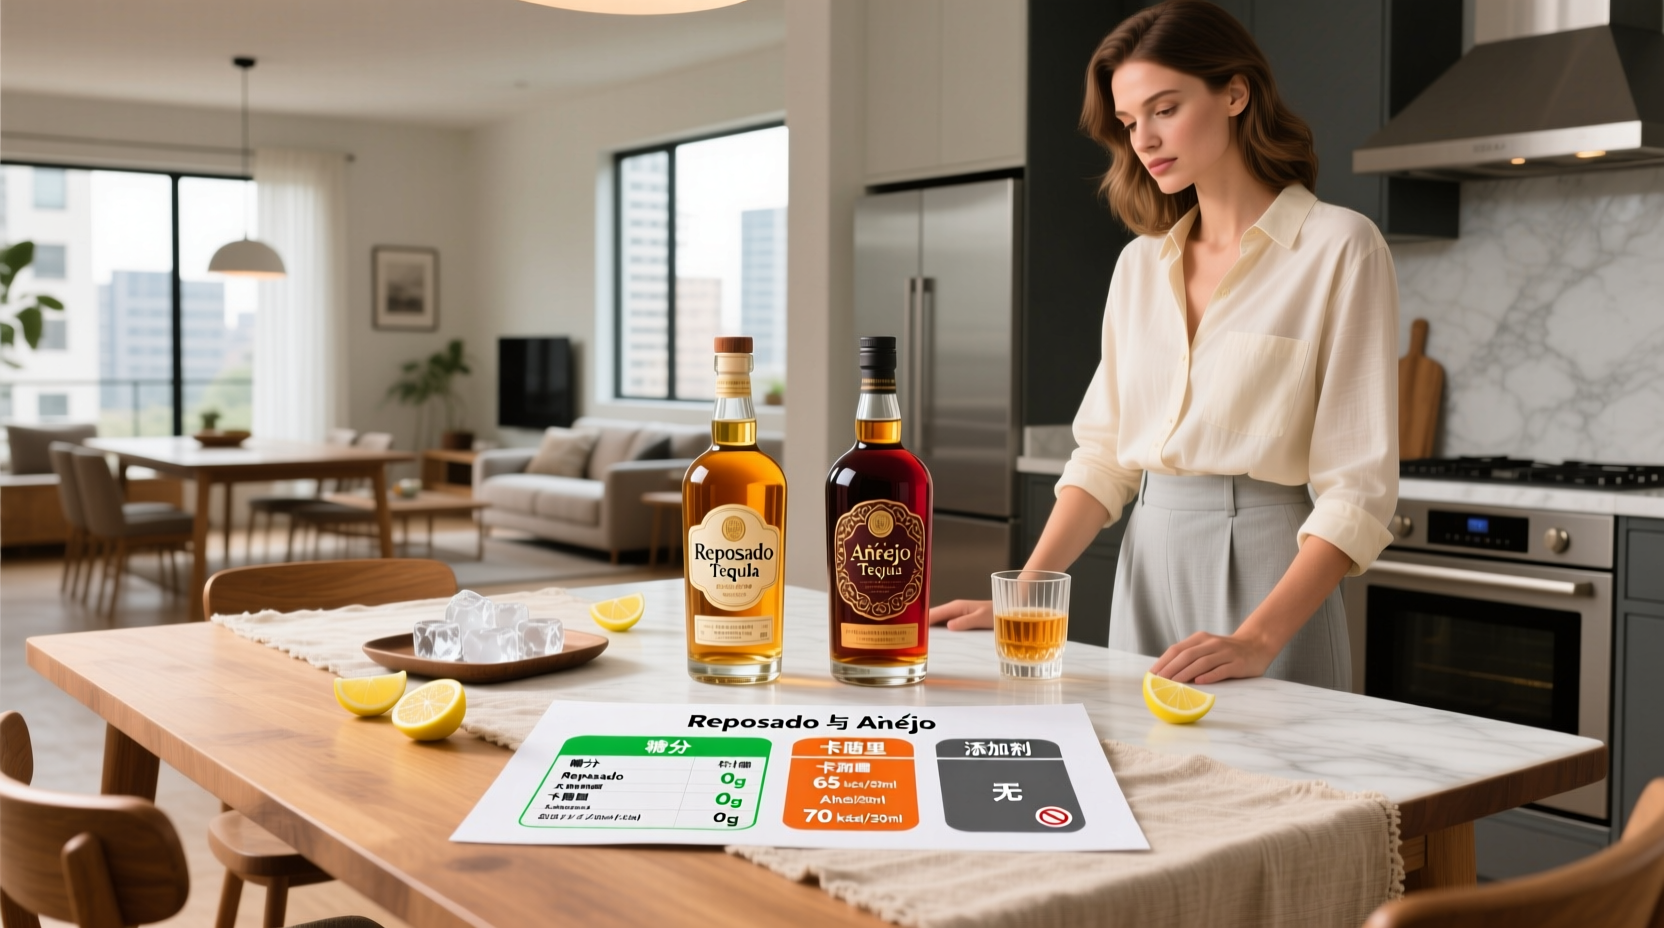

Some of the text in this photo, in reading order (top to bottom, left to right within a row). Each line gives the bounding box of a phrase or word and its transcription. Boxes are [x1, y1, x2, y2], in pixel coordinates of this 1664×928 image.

[695, 543, 774, 563] Reposado
[688, 715, 819, 731] Reposado
[827, 714, 848, 730] 与
[720, 772, 746, 789] 0g
[813, 776, 840, 789] 65
[715, 792, 743, 808] 0g
[992, 782, 1023, 802] 无
[713, 812, 739, 827] 0g
[803, 808, 833, 823] 70
